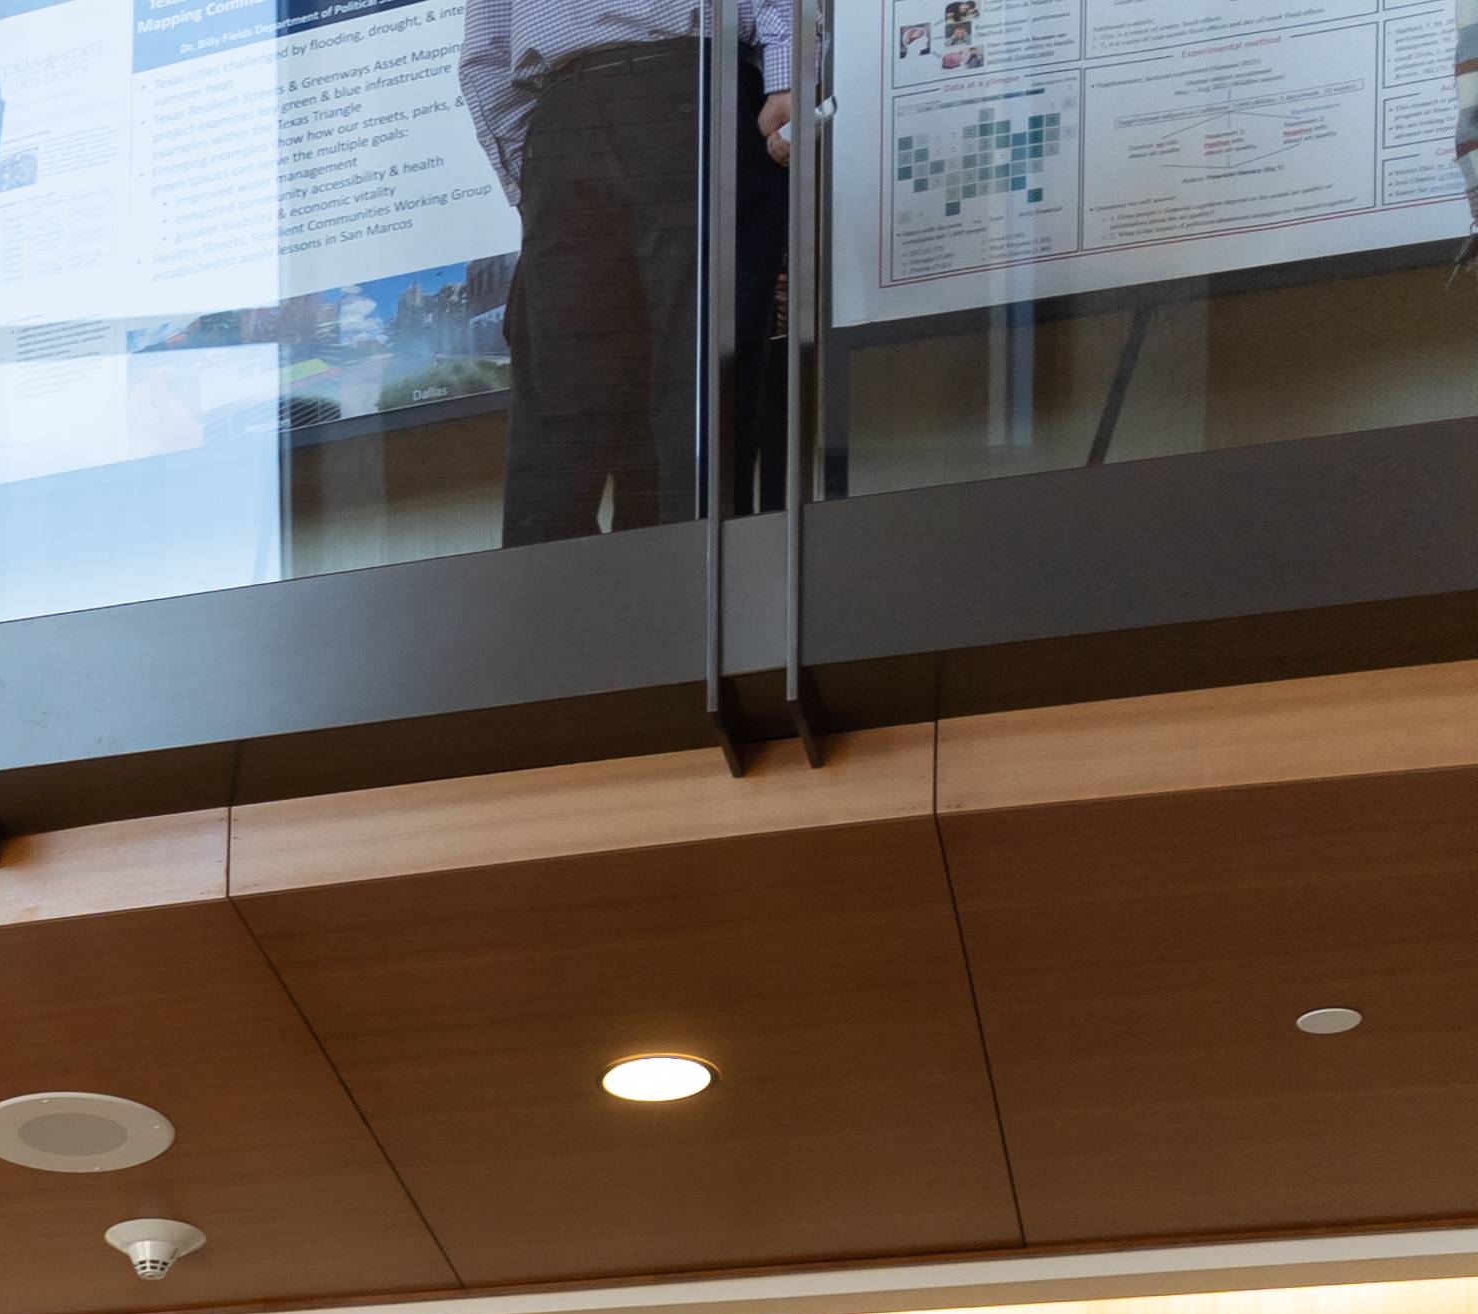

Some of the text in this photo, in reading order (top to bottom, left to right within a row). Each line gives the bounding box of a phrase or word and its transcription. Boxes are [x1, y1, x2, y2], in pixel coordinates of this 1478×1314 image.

[137, 8, 203, 34] Mapping
[198, 36, 219, 50] Billy
[221, 29, 254, 45] Fields
[254, 10, 319, 35] Department
[320, 9, 331, 20] of
[222, 48, 289, 75] challenged
[291, 43, 308, 58] by
[309, 30, 365, 52] flooding,
[368, 17, 423, 39] drought,
[426, 10, 437, 23] &
[241, 85, 285, 105] Streets
[287, 80, 299, 93] &
[301, 66, 371, 91] Greenways
[373, 55, 408, 73] Asset
[281, 64, 451, 114] green & blue infrastructure
[277, 101, 363, 131] Texas Triangle
[307, 125, 335, 142] how
[337, 121, 361, 135] our
[362, 110, 409, 131] streets,
[412, 99, 450, 120] parks,
[455, 95, 465, 108] &
[292, 130, 409, 164] the multiple goals:
[277, 158, 358, 185] management
[311, 156, 444, 195] accessibility & health
[277, 184, 397, 220] & economic vitality
[308, 183, 492, 232] Communities Working Group
[277, 218, 414, 256] lessons in San Marcos
[413, 385, 448, 401] Dallas
